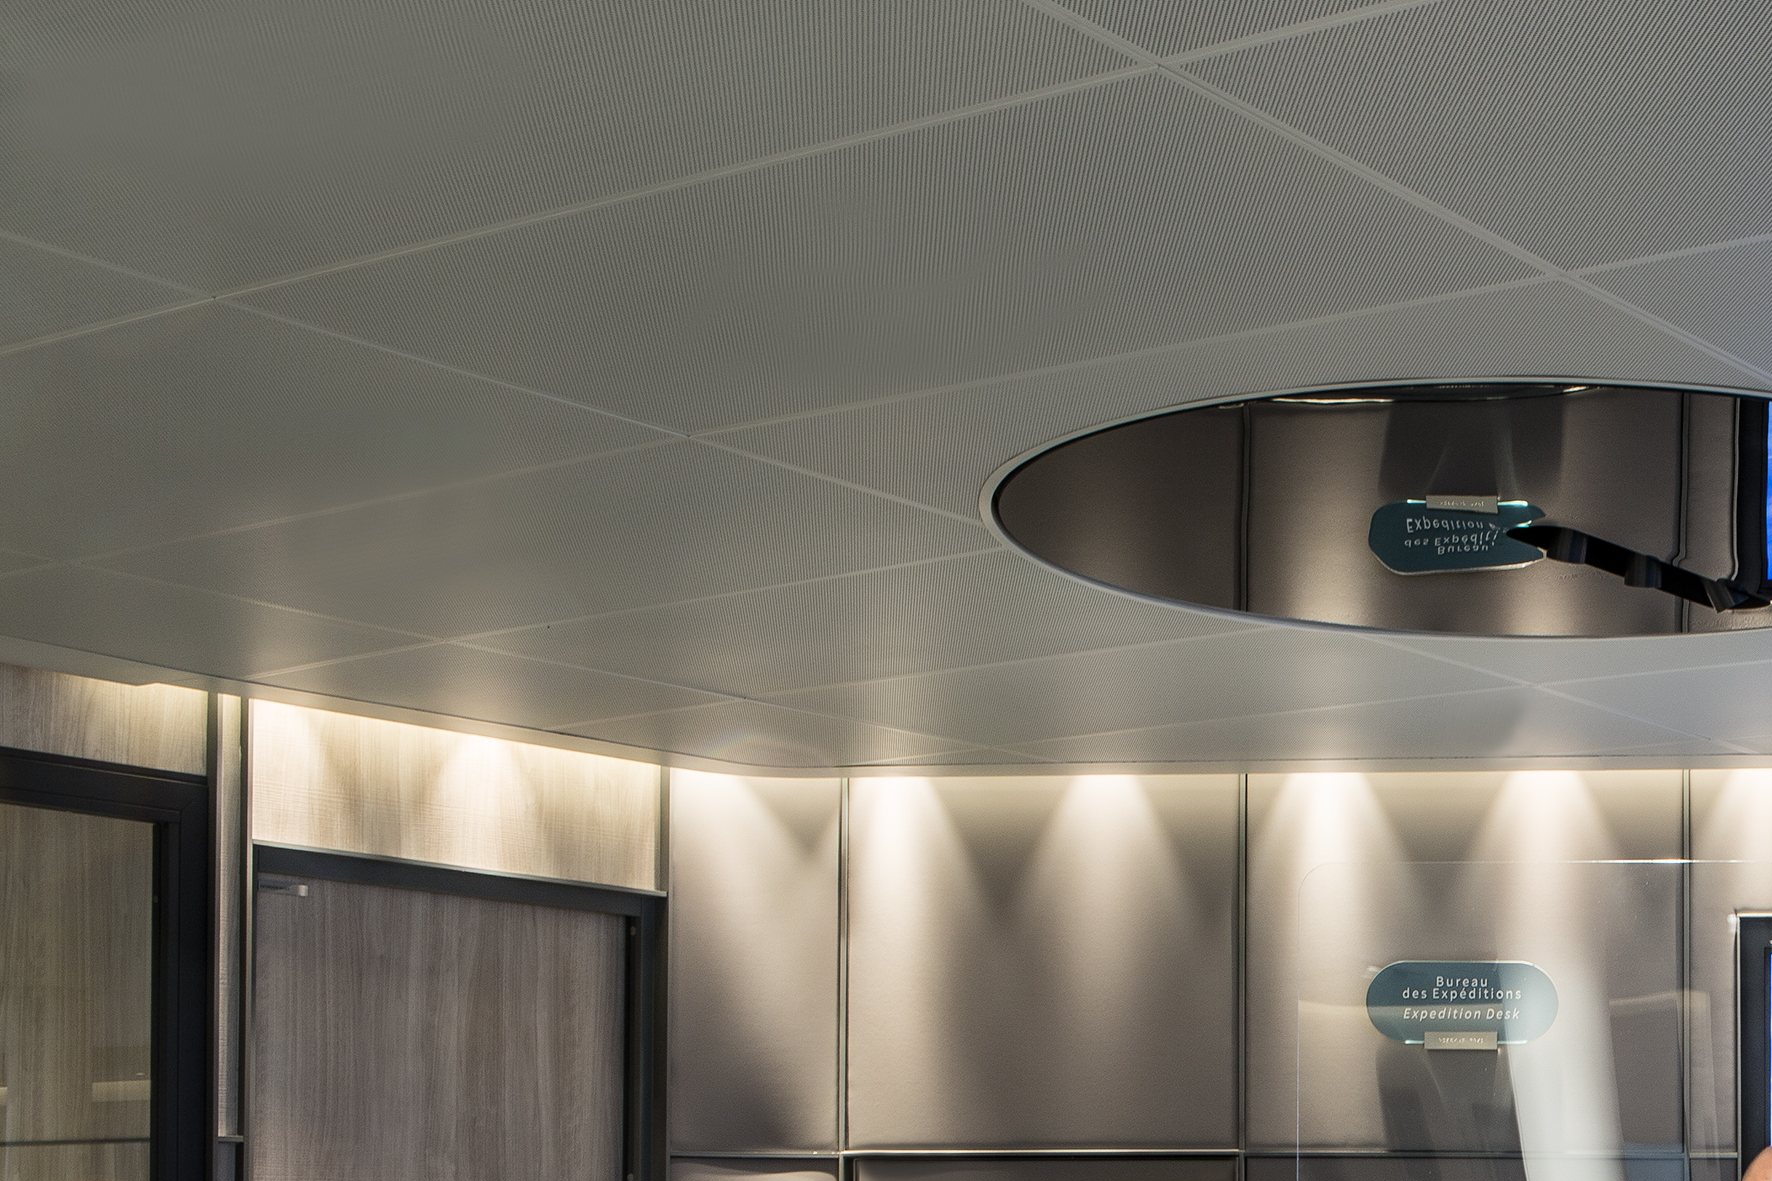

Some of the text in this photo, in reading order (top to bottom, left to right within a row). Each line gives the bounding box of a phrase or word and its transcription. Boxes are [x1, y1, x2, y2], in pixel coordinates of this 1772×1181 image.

[1436, 976, 1488, 987] Bureau
[1402, 987, 1522, 1001] des Expéditions
[1403, 1007, 1520, 1021] Expedition Desk
